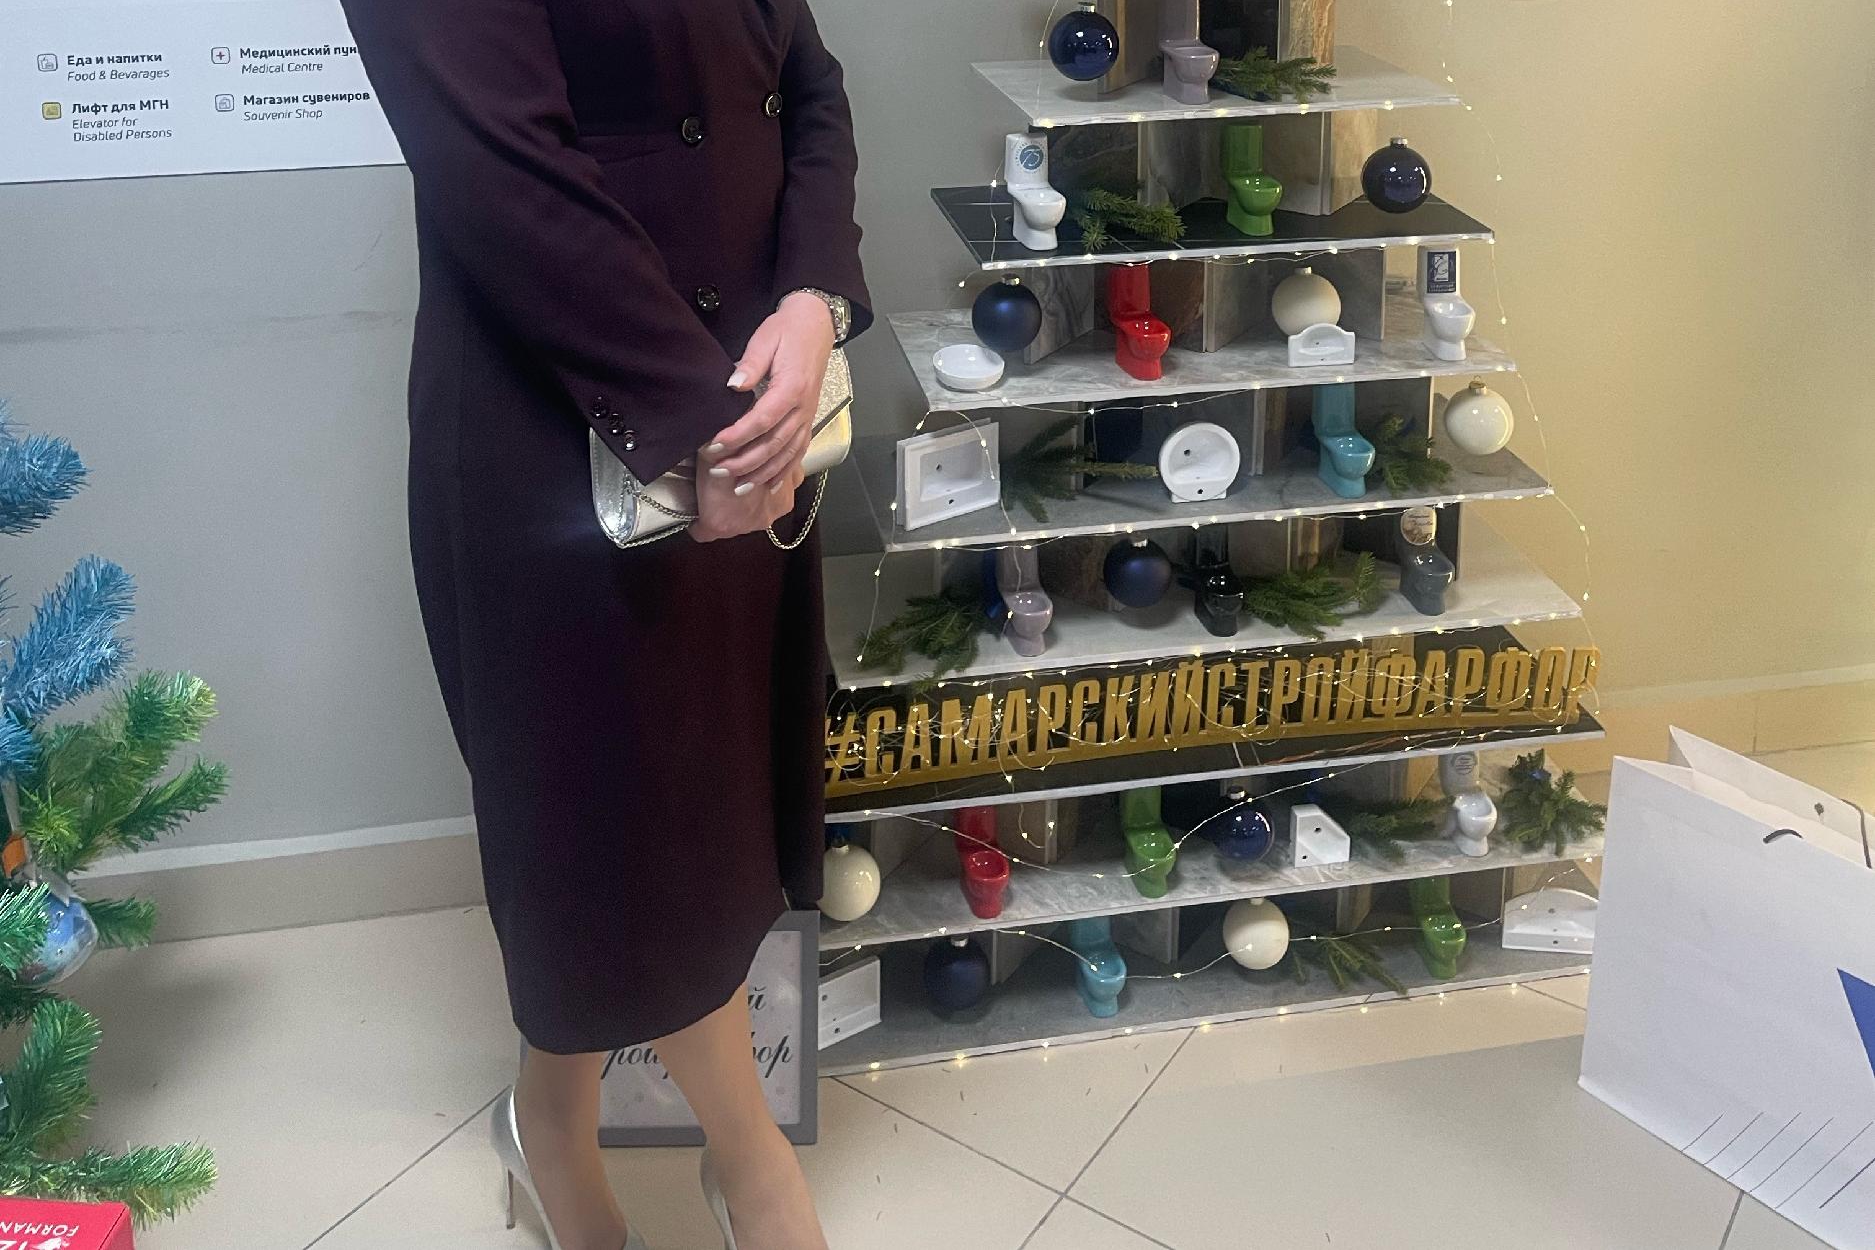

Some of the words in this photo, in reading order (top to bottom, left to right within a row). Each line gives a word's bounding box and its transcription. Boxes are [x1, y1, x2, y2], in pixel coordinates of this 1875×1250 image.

[239, 45, 331, 60] Медицинский
[333, 46, 358, 57] пун
[67, 55, 93, 67] Еда
[95, 55, 104, 65] и
[107, 54, 162, 64] напитки
[241, 63, 285, 74] Medical
[287, 62, 323, 72] Centre
[67, 71, 96, 81] Food
[99, 70, 107, 80] &
[110, 69, 170, 81] Bevarages
[243, 94, 299, 106] Магазин
[302, 92, 371, 105] сувениров
[72, 103, 108, 116] Лифт
[111, 103, 136, 114] для
[139, 99, 169, 111] МГН
[243, 111, 292, 122] Souvenir
[295, 108, 323, 120] Shop
[72, 118, 119, 129] Elevator
[121, 116, 139, 127] for
[73, 130, 123, 142] Disabled
[125, 129, 173, 140] Persons
[825, 646, 1601, 783] #САМАРСКИЙСТРОЙФАРФОР
